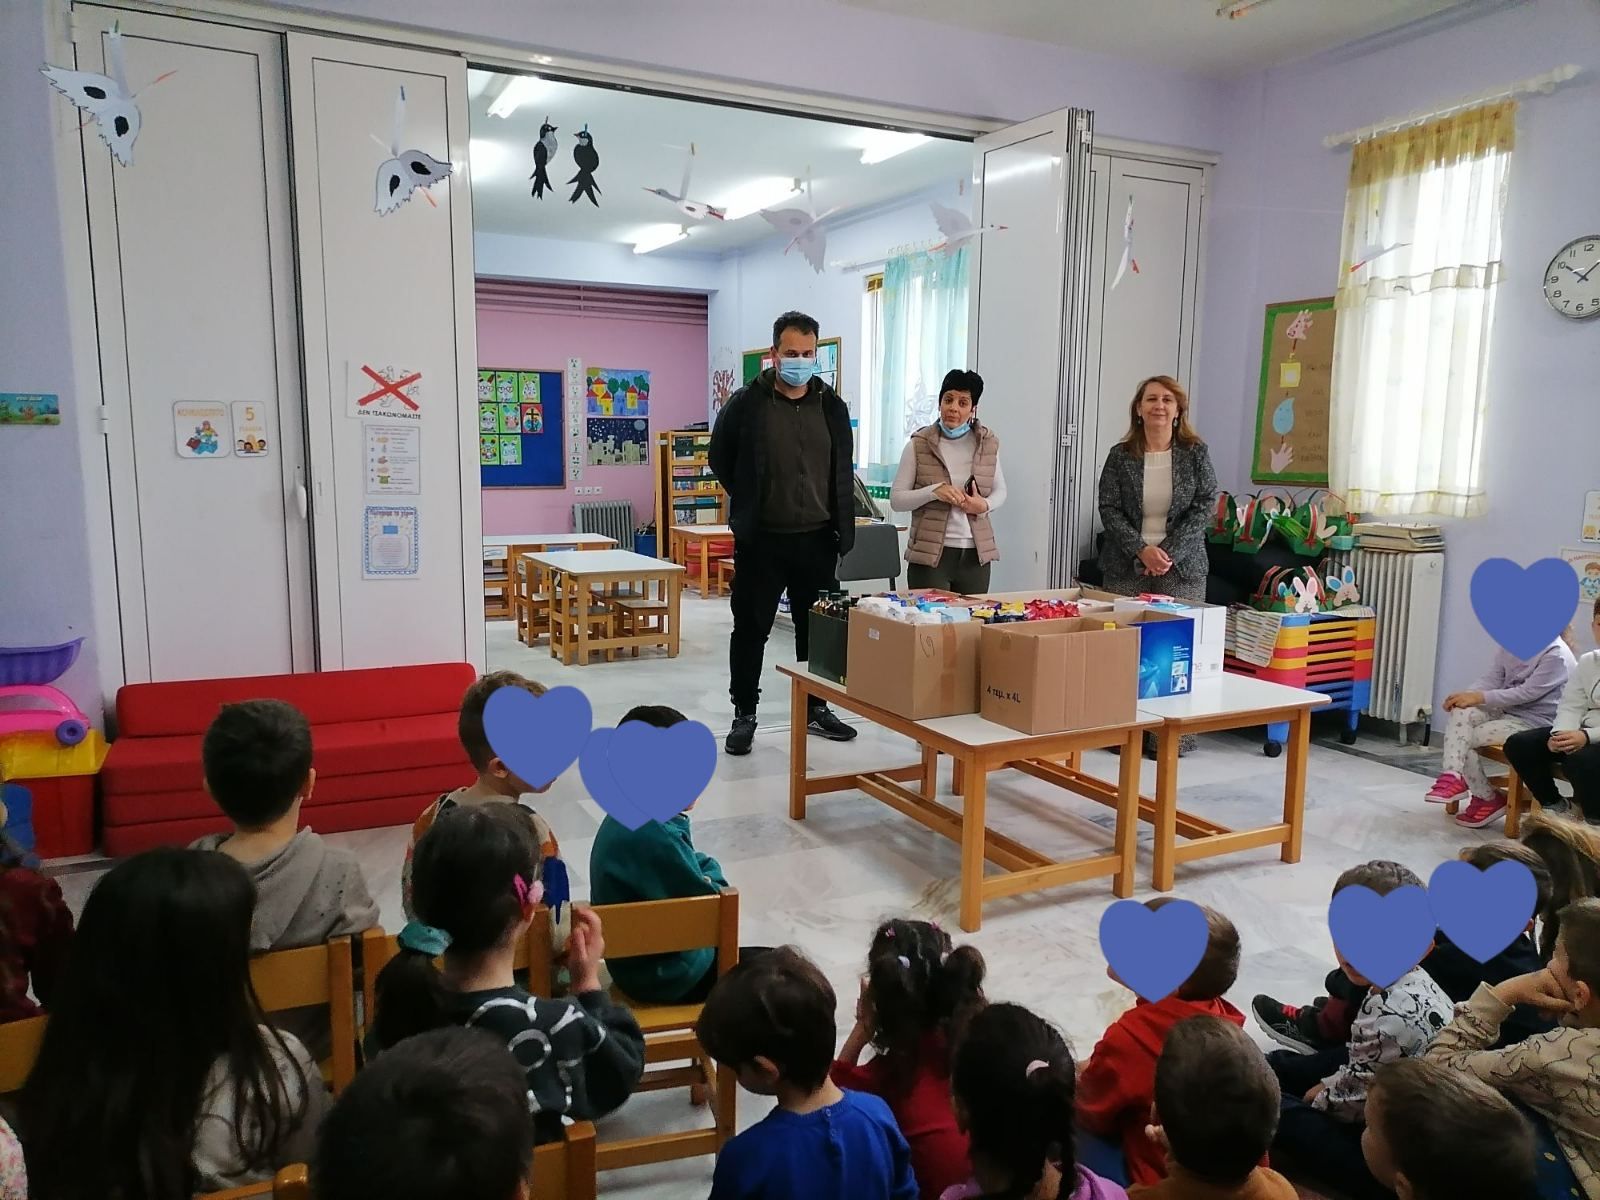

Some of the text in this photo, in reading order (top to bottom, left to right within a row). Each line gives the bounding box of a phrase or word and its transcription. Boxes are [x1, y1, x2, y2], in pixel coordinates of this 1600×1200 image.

[1583, 243, 1595, 252] 12
[1569, 249, 1577, 258] 11
[1557, 261, 1566, 270] 10
[1550, 275, 1559, 284] 9
[1553, 289, 1562, 298] 8
[1562, 299, 1570, 308] 7
[1590, 298, 1600, 307] 5
[1575, 303, 1584, 312] 6
[245, 406, 255, 421] 5
